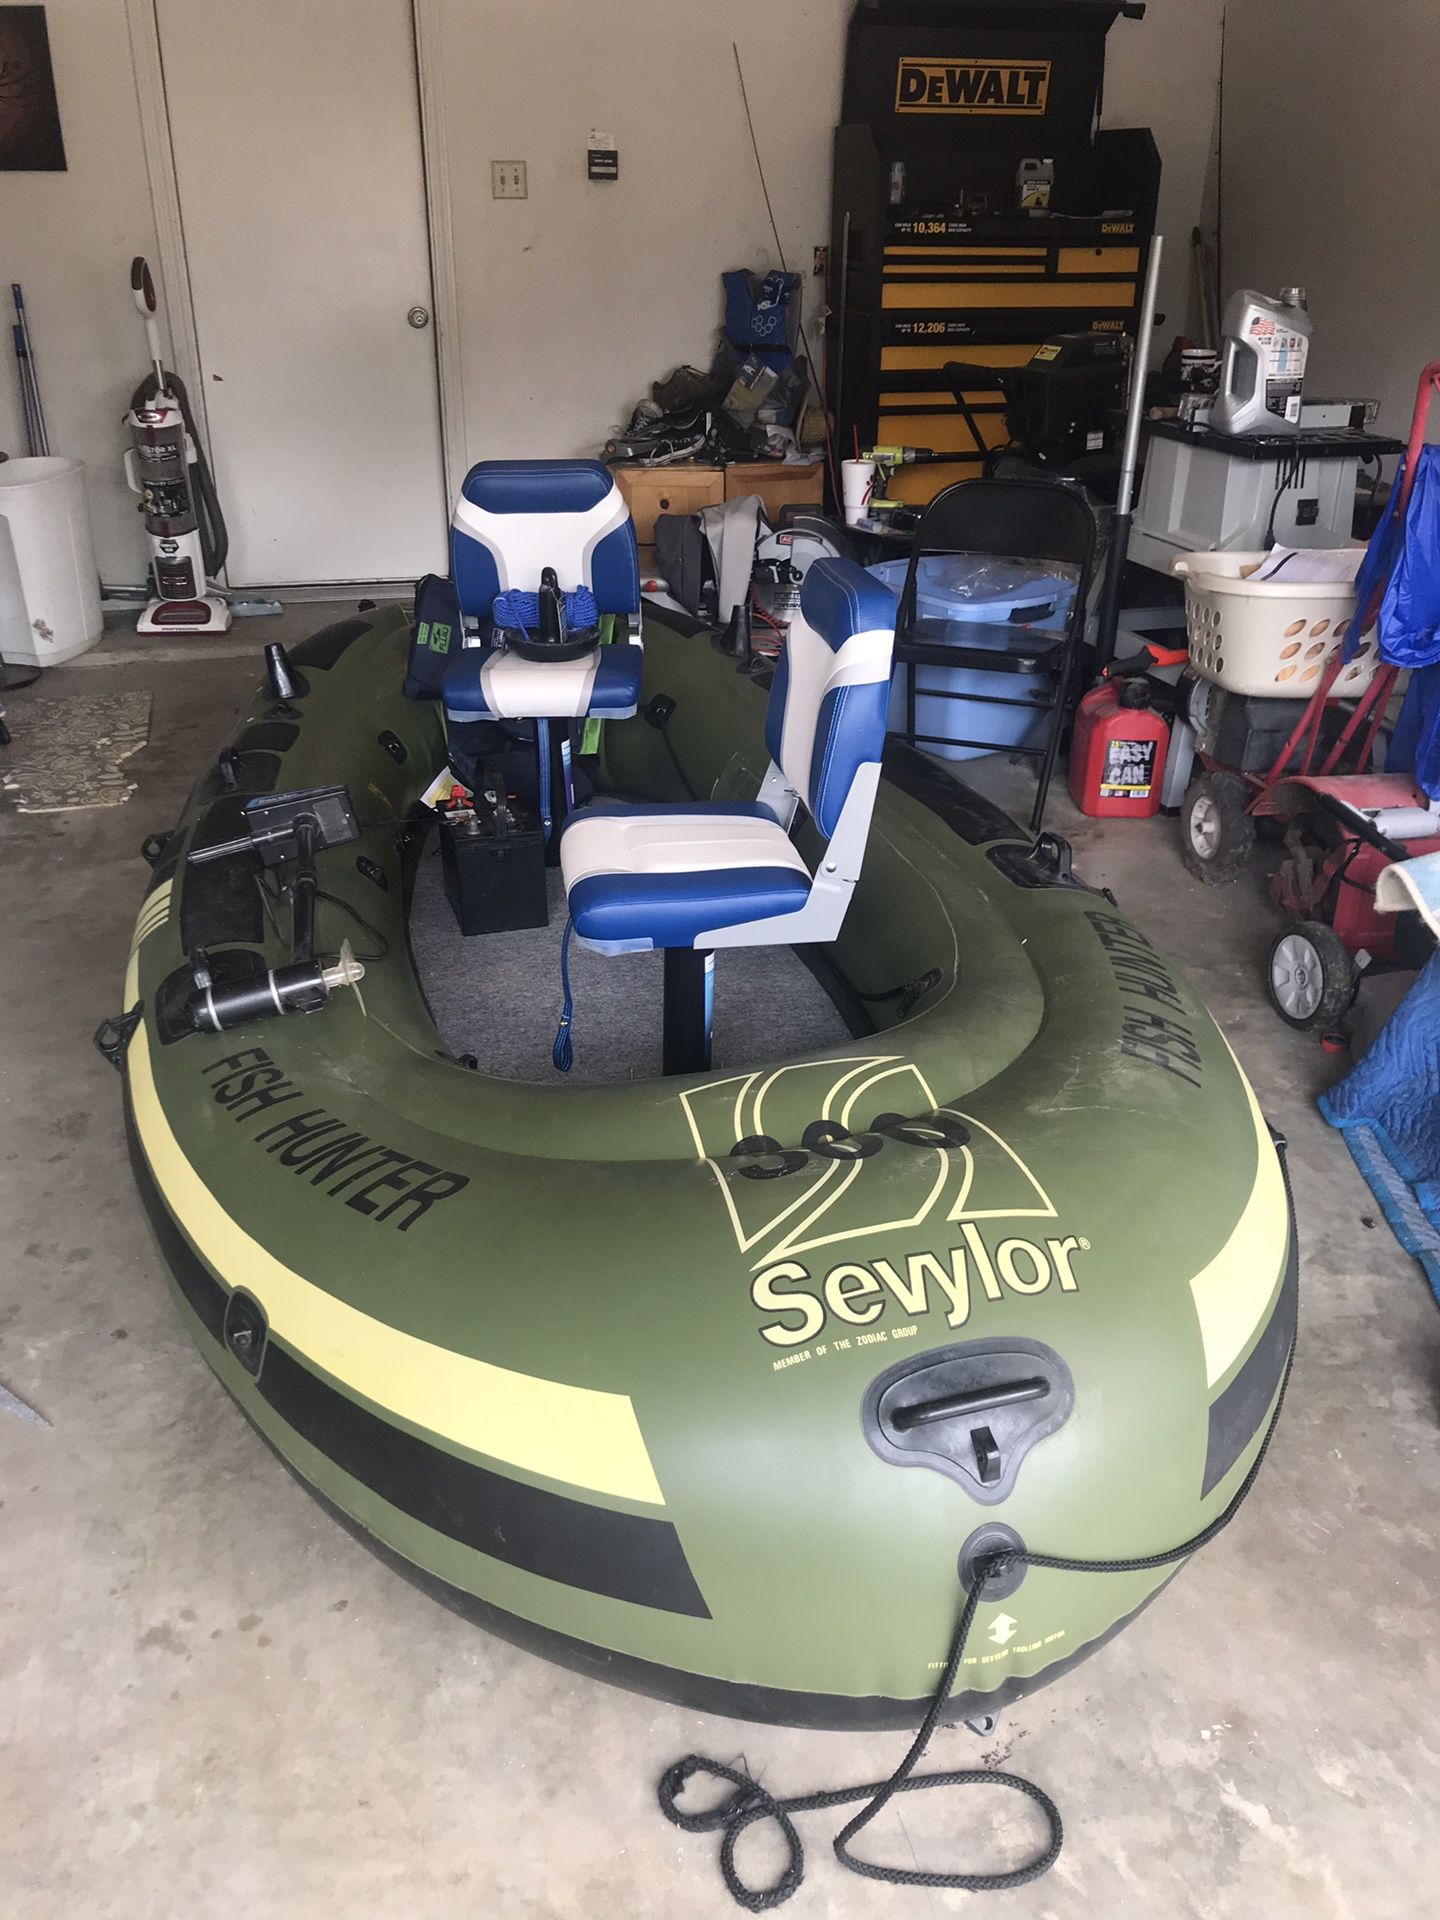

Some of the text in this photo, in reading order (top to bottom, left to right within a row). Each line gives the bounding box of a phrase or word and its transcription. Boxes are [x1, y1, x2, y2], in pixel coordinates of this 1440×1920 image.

[913, 222, 946, 234] 10,364
[913, 322, 945, 333] 12,206
[1110, 742, 1153, 764] EASY
[1109, 764, 1144, 784] CAN
[1120, 1005, 1202, 1088] FISH
[202, 1047, 470, 1231] FISH HUNTER
[773, 1324, 918, 1371] MEMBER OF THE ZODIAC GROUP
[963, 1657, 977, 1665] FOR
